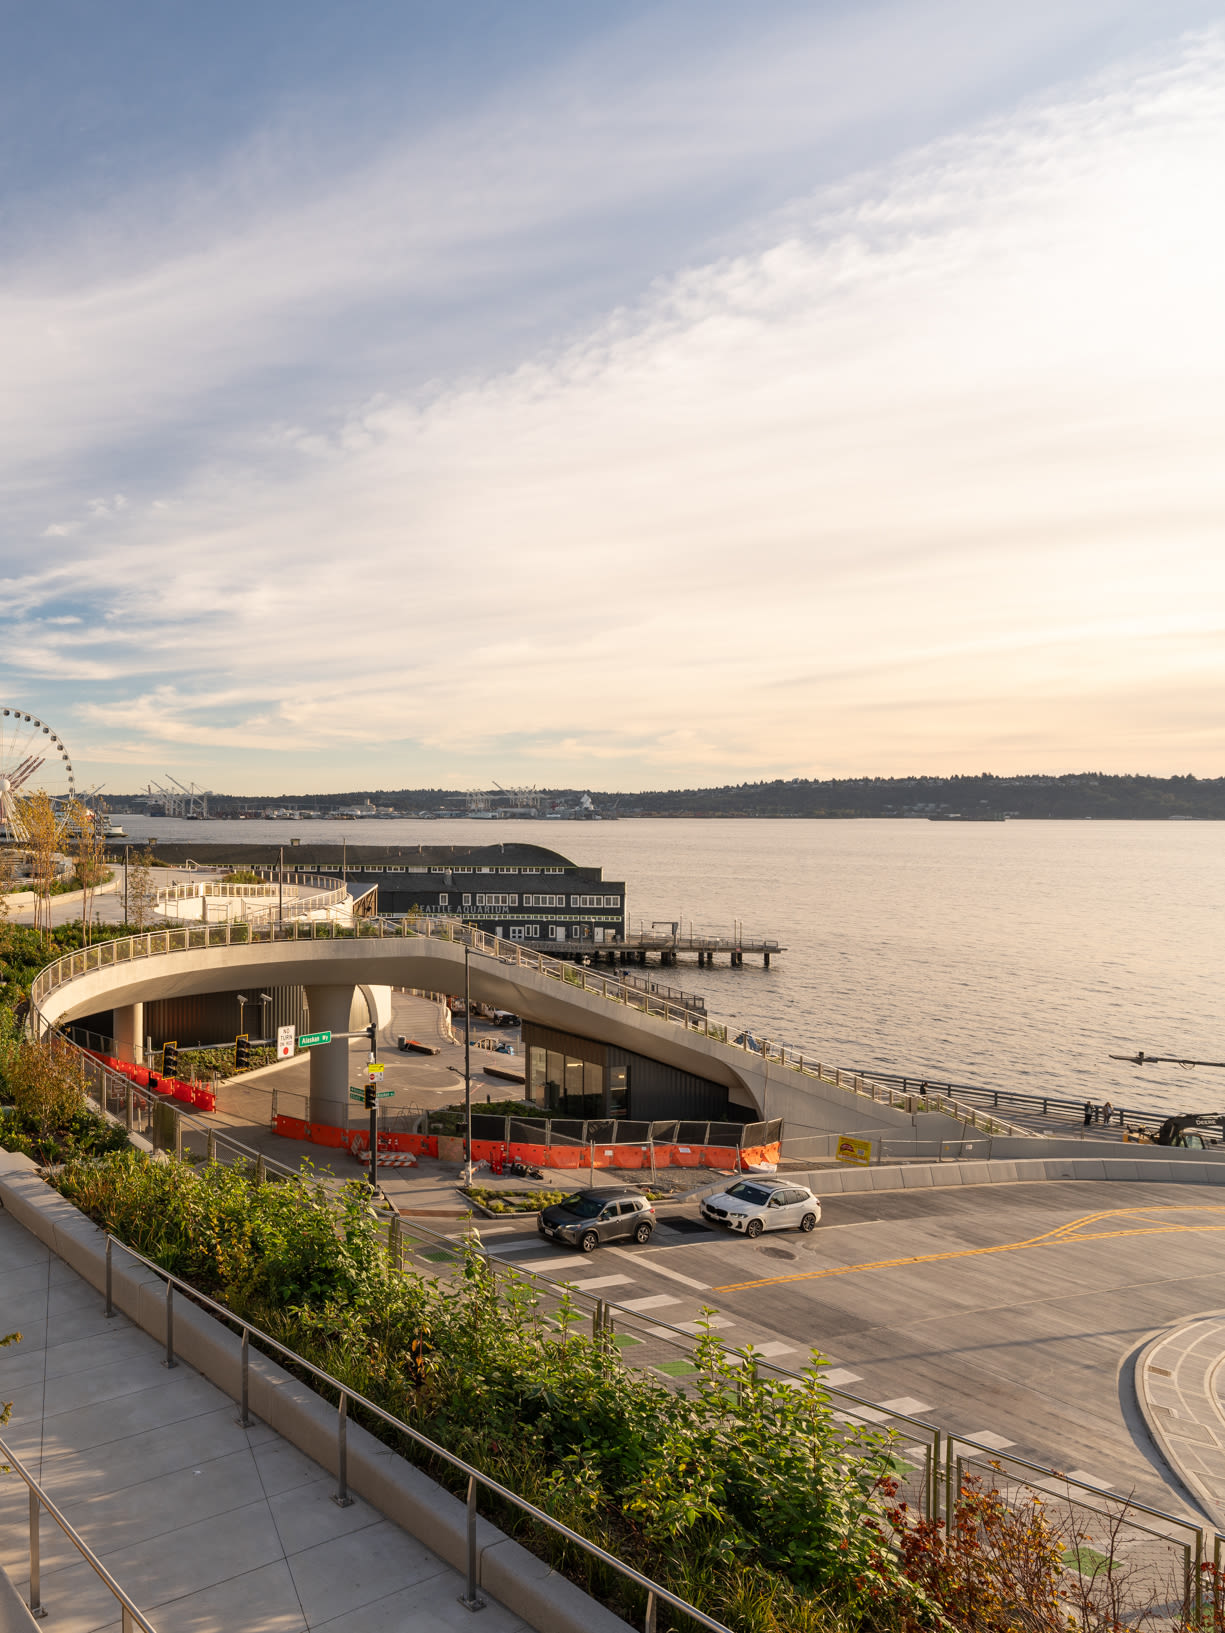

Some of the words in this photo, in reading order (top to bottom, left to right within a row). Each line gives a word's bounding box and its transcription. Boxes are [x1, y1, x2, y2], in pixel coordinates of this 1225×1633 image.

[418, 905, 452, 913] EATTLE
[456, 905, 510, 914] AQUARIUM
[302, 1036, 320, 1044] Alaskan
